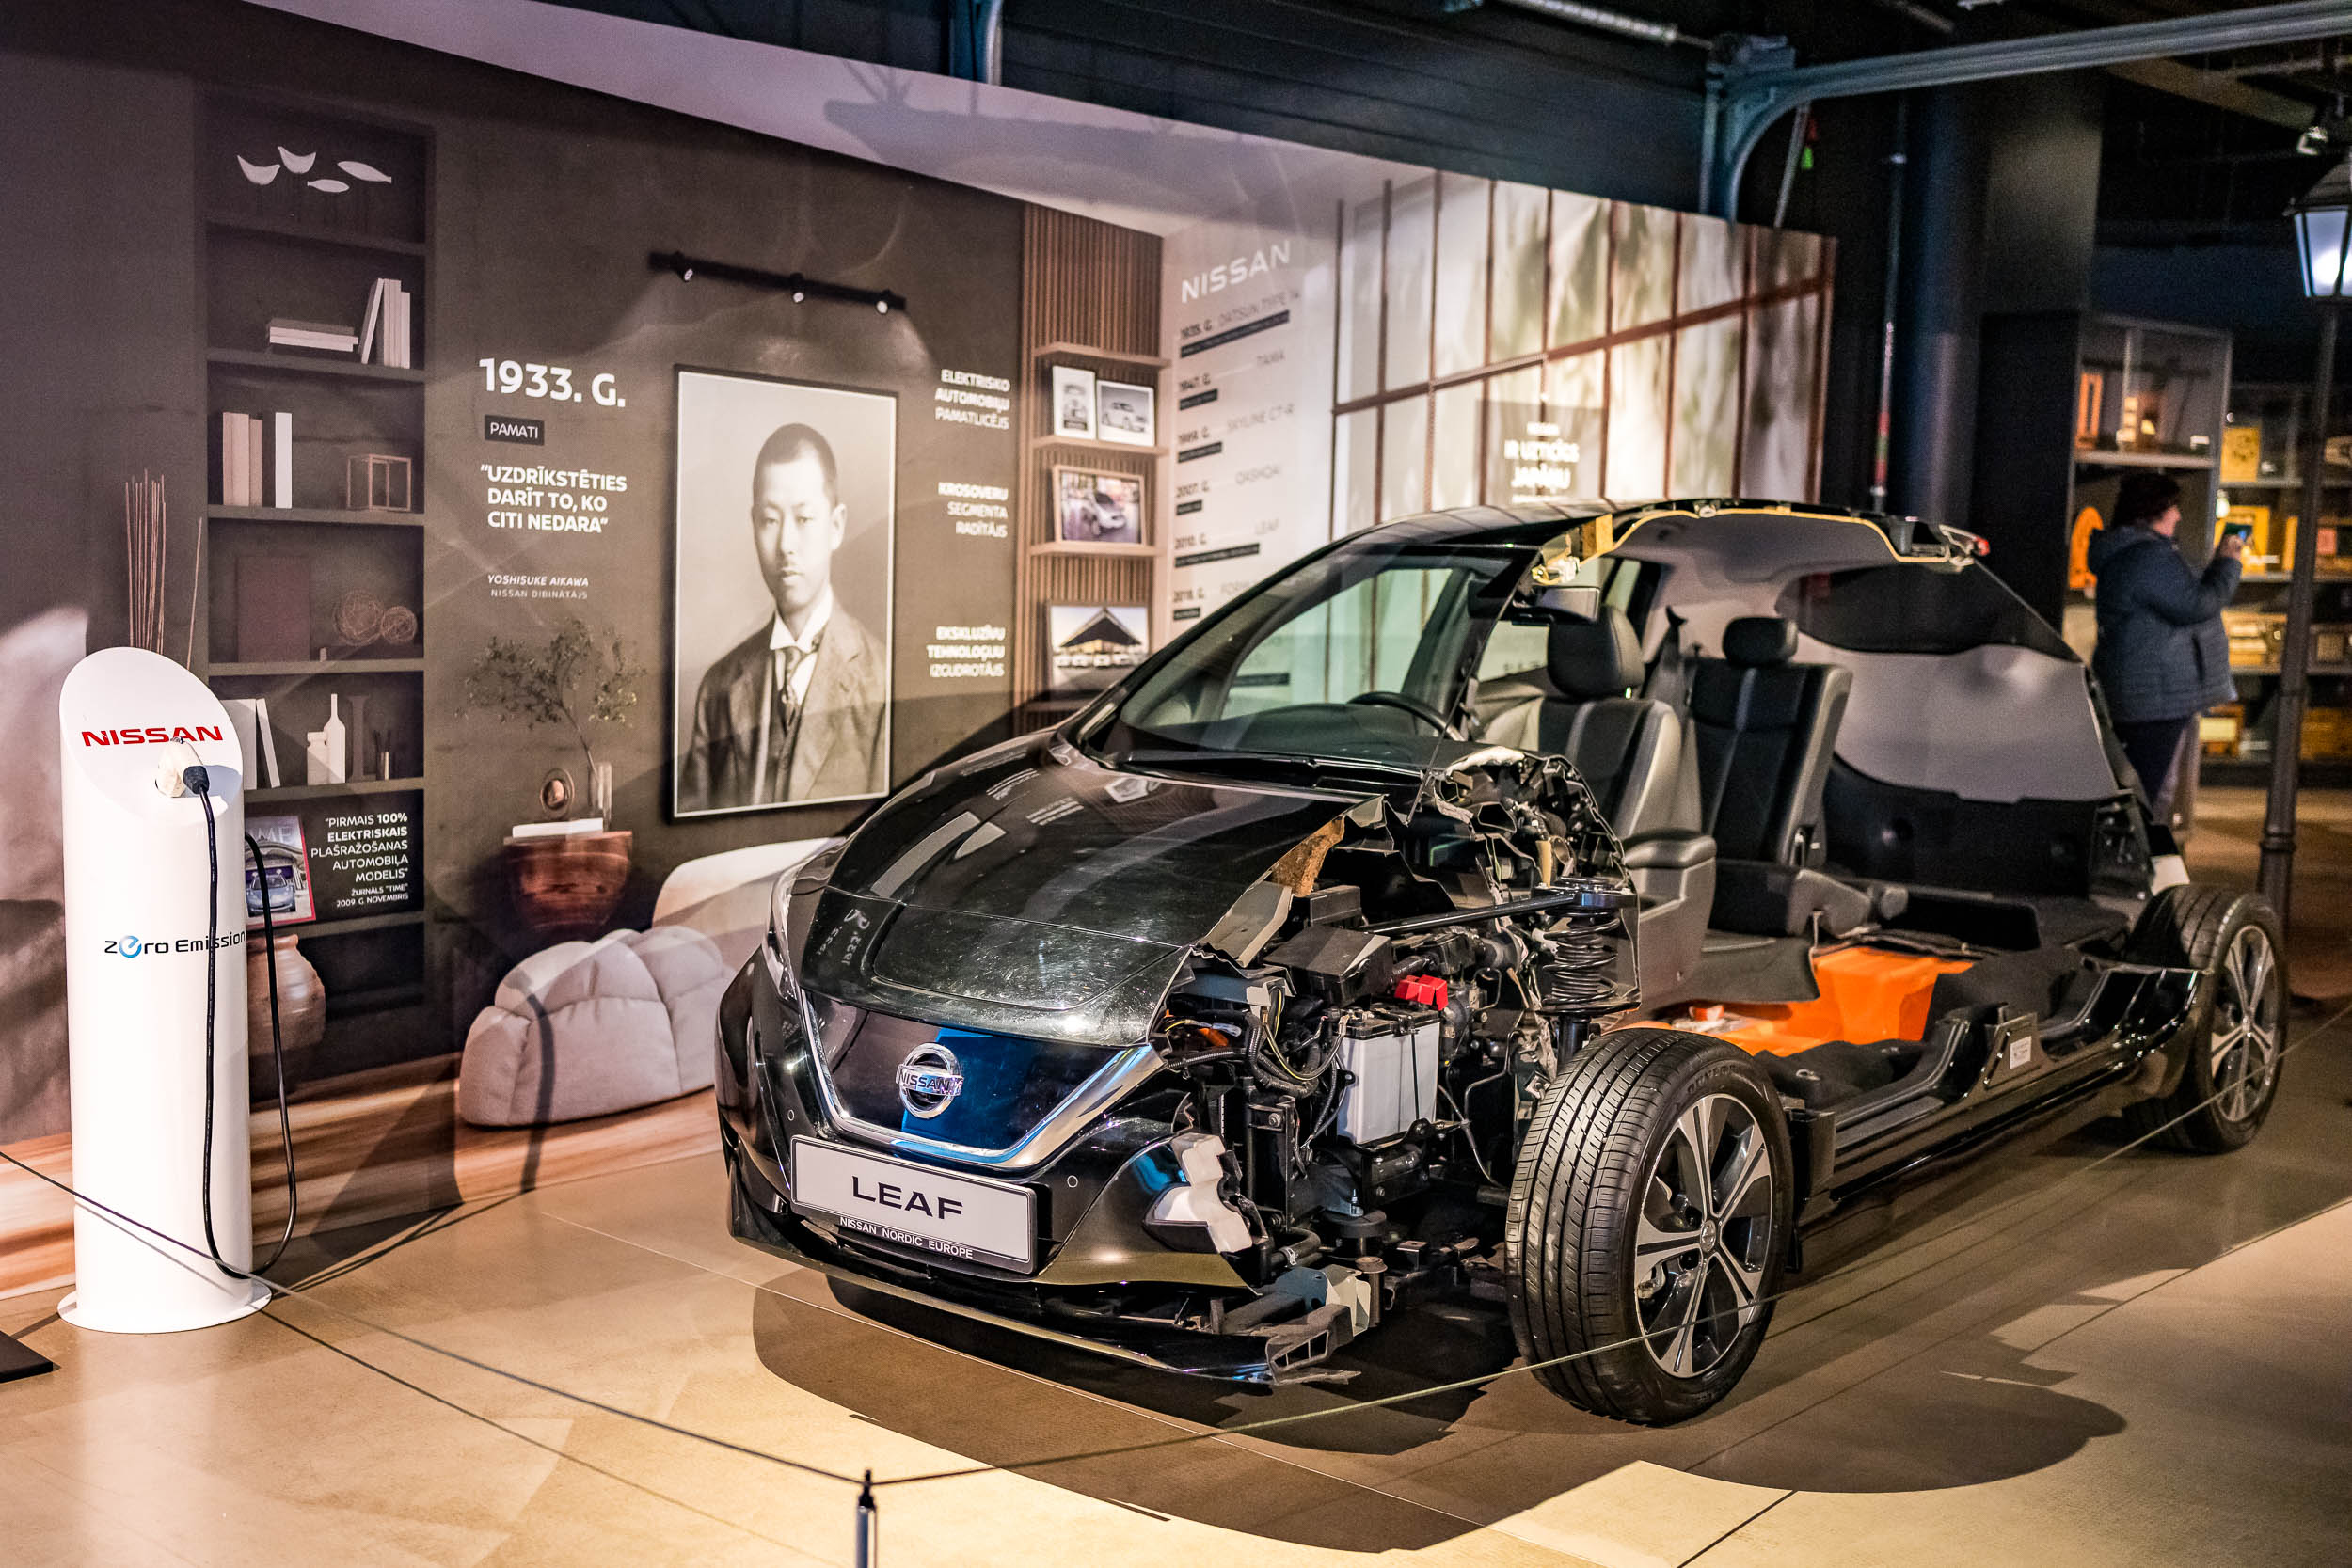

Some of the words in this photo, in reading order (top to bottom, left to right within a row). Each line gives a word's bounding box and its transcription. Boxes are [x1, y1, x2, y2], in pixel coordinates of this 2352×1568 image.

[1182, 240, 1290, 303] NISSAN
[479, 357, 582, 403] 1933.
[591, 372, 626, 407] G.
[941, 369, 1011, 392] ELEKTRISKO
[490, 422, 538, 438] PAMATI
[487, 487, 544, 508] DARĪT
[548, 492, 578, 513] TO,
[581, 495, 608, 512] KO
[487, 511, 523, 529] CITI
[487, 574, 547, 586] YOSHISUKE
[548, 577, 589, 588] AIKAWA
[490, 589, 527, 598] NISSAN
[81, 725, 224, 747] NISSAN
[376, 812, 408, 824] 100%
[327, 826, 408, 843] ELEKTRISKAIS
[310, 839, 408, 858] PLAŠRAŽOŠANAS
[332, 854, 409, 871] AUTOMOBIĻA
[366, 893, 409, 904] NOVEMBRIS
[899, 1070, 950, 1092] NISSAN
[852, 1176, 963, 1220] LEAF
[839, 1216, 877, 1235] NISSAN
[882, 1228, 923, 1246] NORDIC
[928, 1240, 974, 1259] EUROPE
